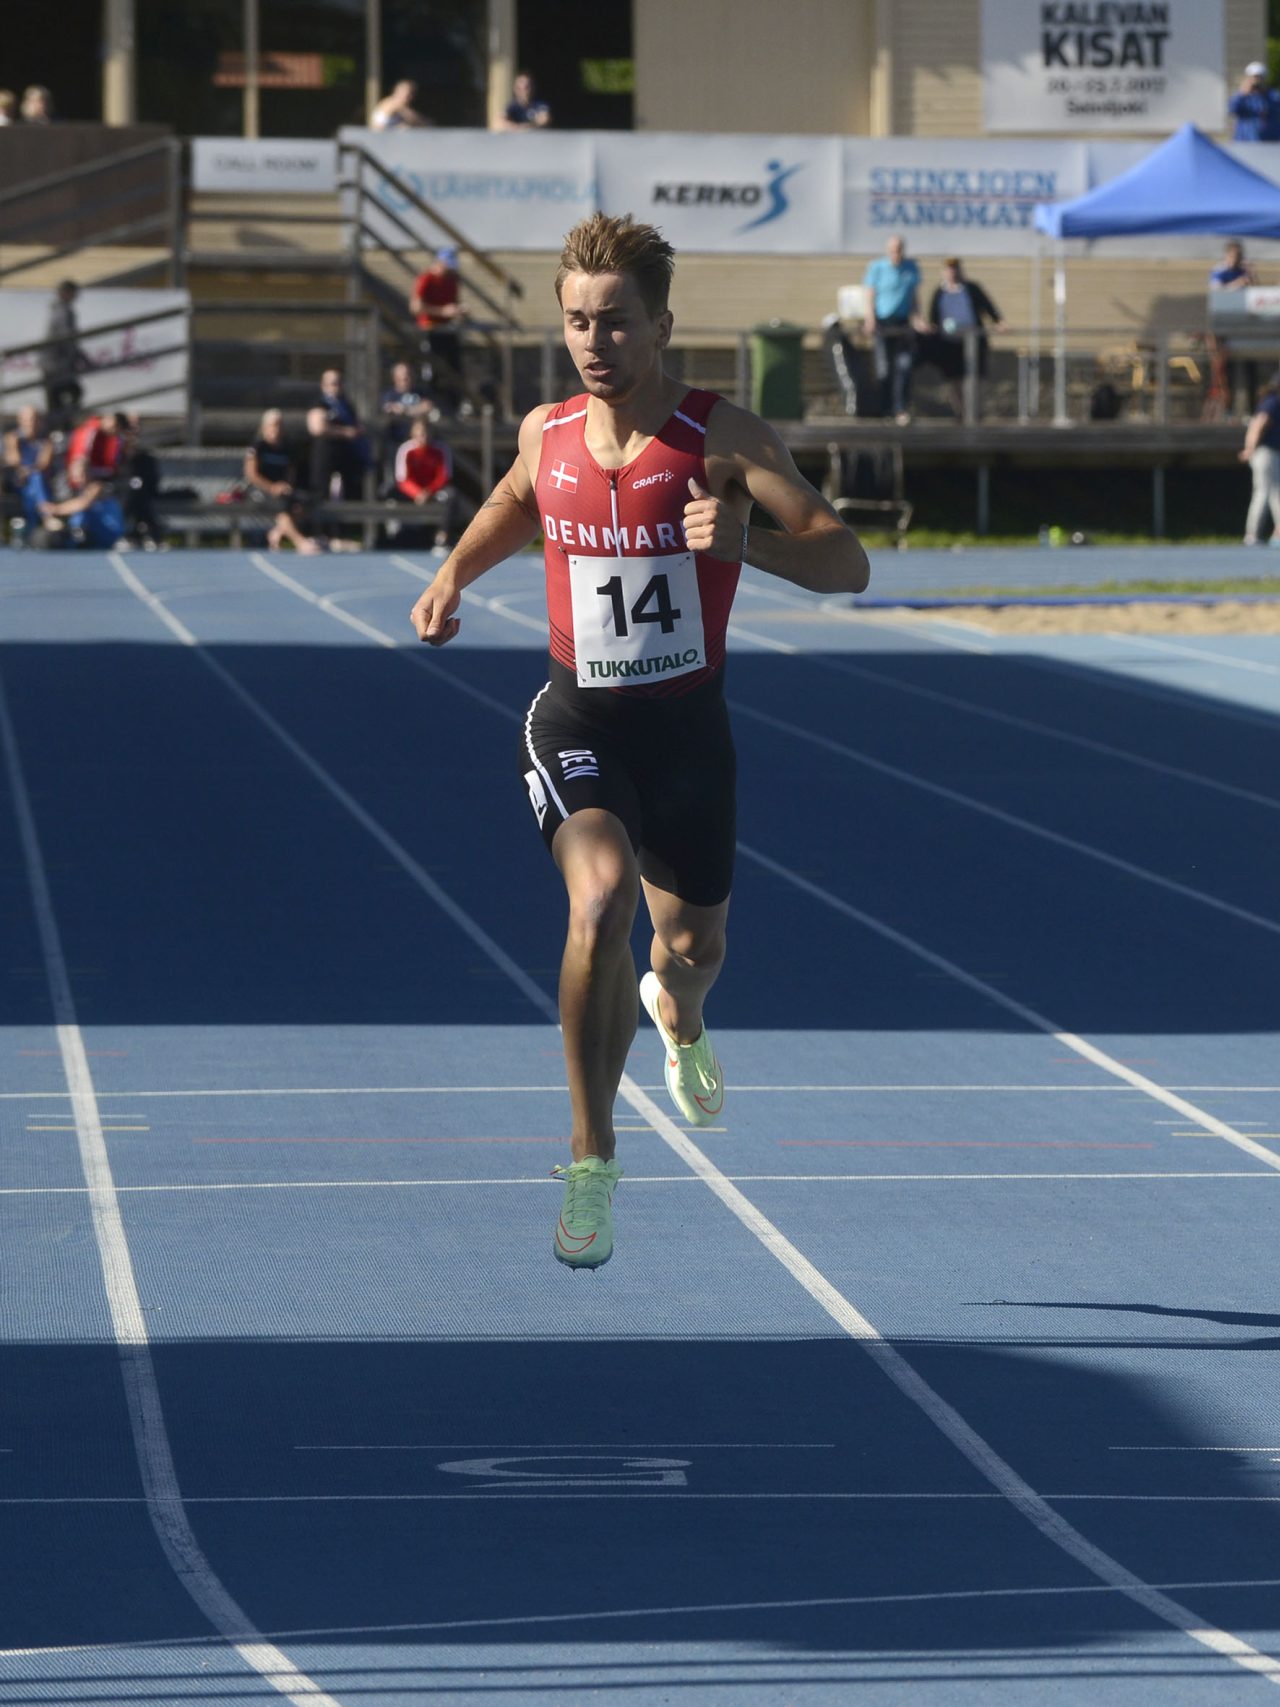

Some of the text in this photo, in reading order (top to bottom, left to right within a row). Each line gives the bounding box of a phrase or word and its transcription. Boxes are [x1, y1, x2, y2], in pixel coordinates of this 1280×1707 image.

[1041, 0, 1168, 25] KALEVAN
[1043, 31, 1170, 68] KISAT
[653, 183, 761, 204] KERKO
[632, 472, 665, 490] CRAFT
[596, 574, 681, 637] 14
[558, 750, 600, 781] DEN
